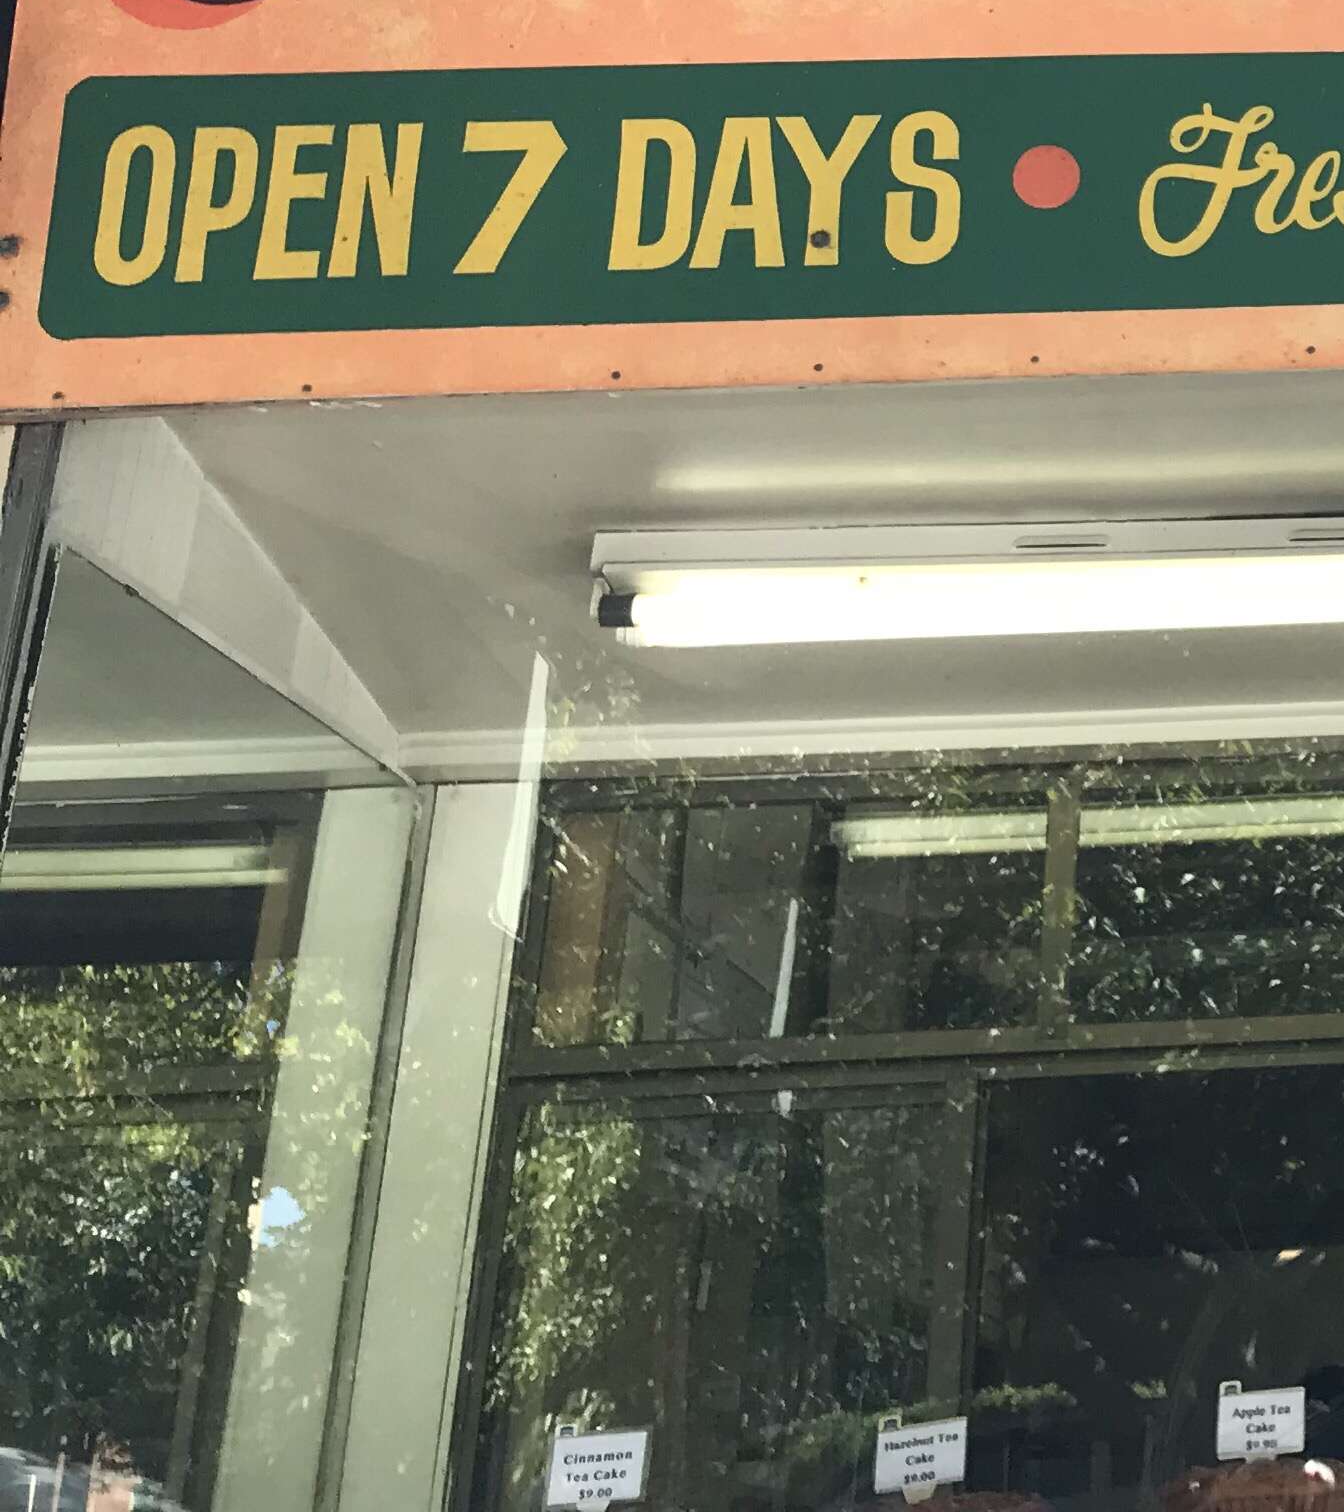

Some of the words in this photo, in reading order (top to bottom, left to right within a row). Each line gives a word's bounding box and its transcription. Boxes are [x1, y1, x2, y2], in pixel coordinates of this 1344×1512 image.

[94, 121, 423, 286] OPEN
[453, 120, 567, 275] 7
[606, 110, 960, 271] DAYS
[563, 1450, 633, 1466] Cinnamon
[566, 1472, 589, 1483] Tea
[593, 1467, 627, 1482] Cake
[579, 1487, 613, 1500] $9.00
